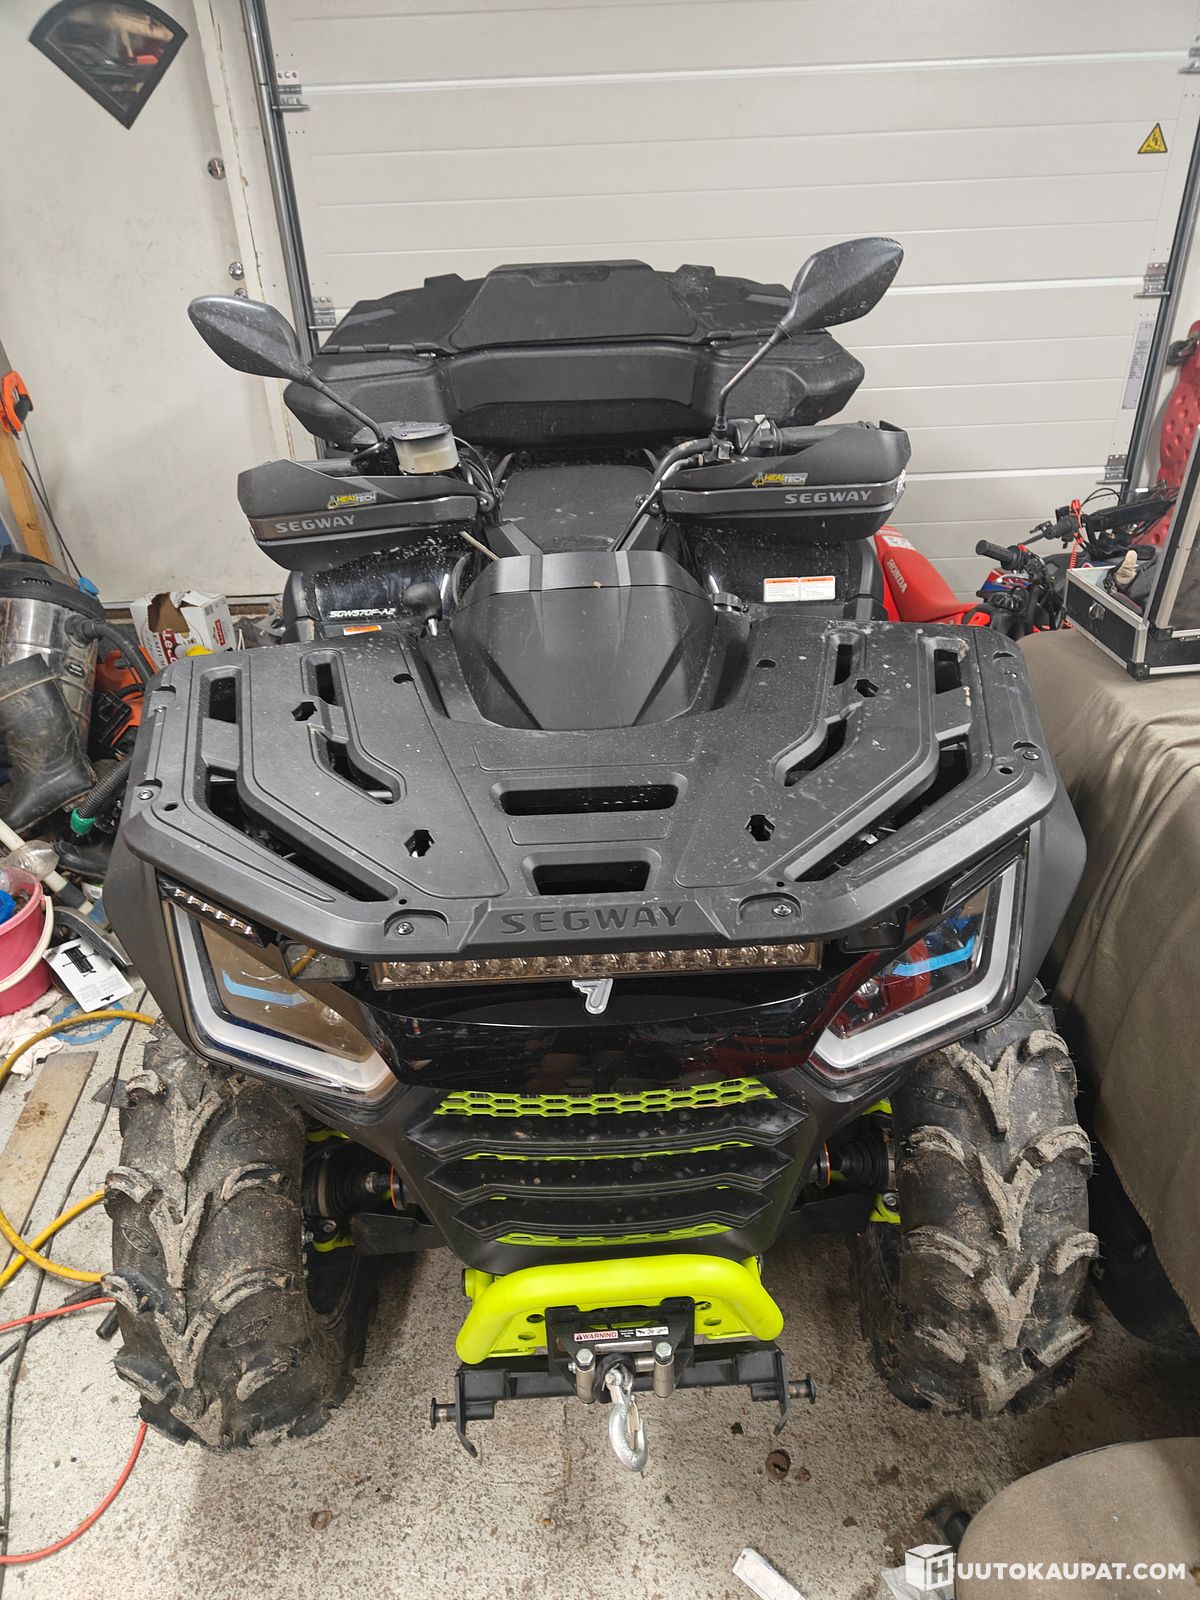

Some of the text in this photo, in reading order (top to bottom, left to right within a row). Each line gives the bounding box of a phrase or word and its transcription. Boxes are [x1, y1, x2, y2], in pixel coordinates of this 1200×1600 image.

[784, 490, 872, 504] SEGWAY
[274, 515, 355, 533] SEGWAY
[887, 559, 908, 594] HONDA
[501, 905, 683, 935] SEGWAY
[583, 1331, 617, 1341] WARNING
